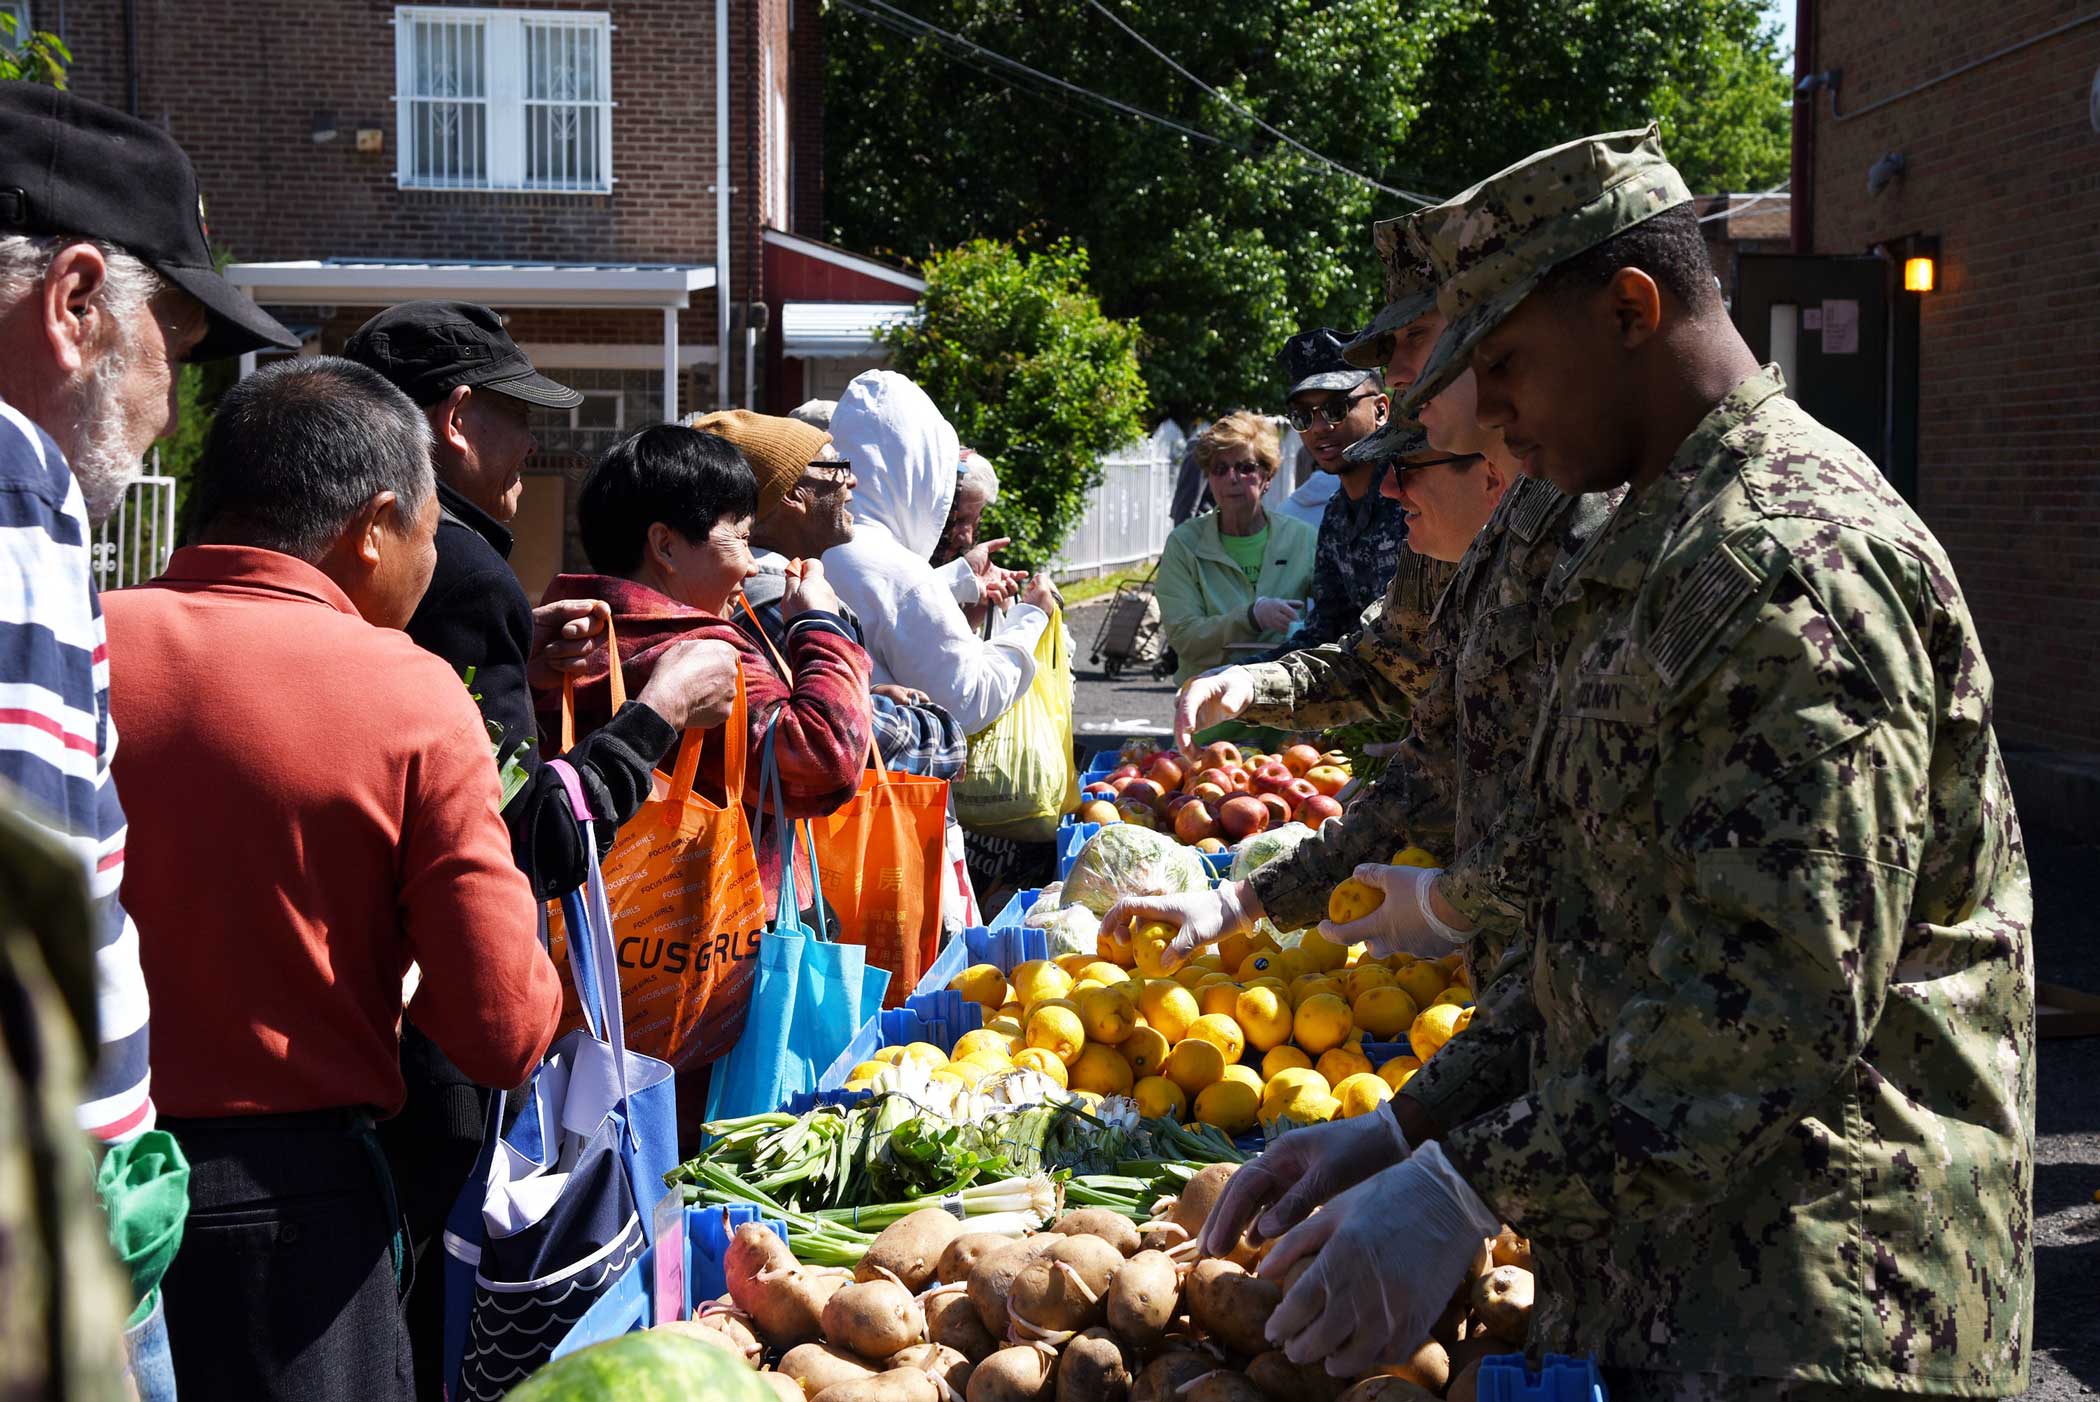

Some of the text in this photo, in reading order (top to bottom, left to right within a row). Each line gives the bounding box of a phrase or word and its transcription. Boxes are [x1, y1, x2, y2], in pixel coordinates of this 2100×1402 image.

[616, 845, 636, 860] FOCUS
[636, 832, 656, 846] GIRLS
[648, 843, 671, 858] FOCUS
[627, 869, 648, 881] GIRLS
[640, 871, 683, 894] FOCUS GIRLS
[663, 886, 686, 899] FOCUS
[620, 905, 640, 918] GIRLS
[633, 914, 655, 928] FOCUS
[655, 905, 674, 917] GIRLS
[721, 910, 739, 927] FOCUS
[738, 898, 755, 912] GIRLS
[654, 920, 677, 934] FOCUS
[617, 936, 690, 974] CUS
[638, 990, 661, 1003] FOCUS
